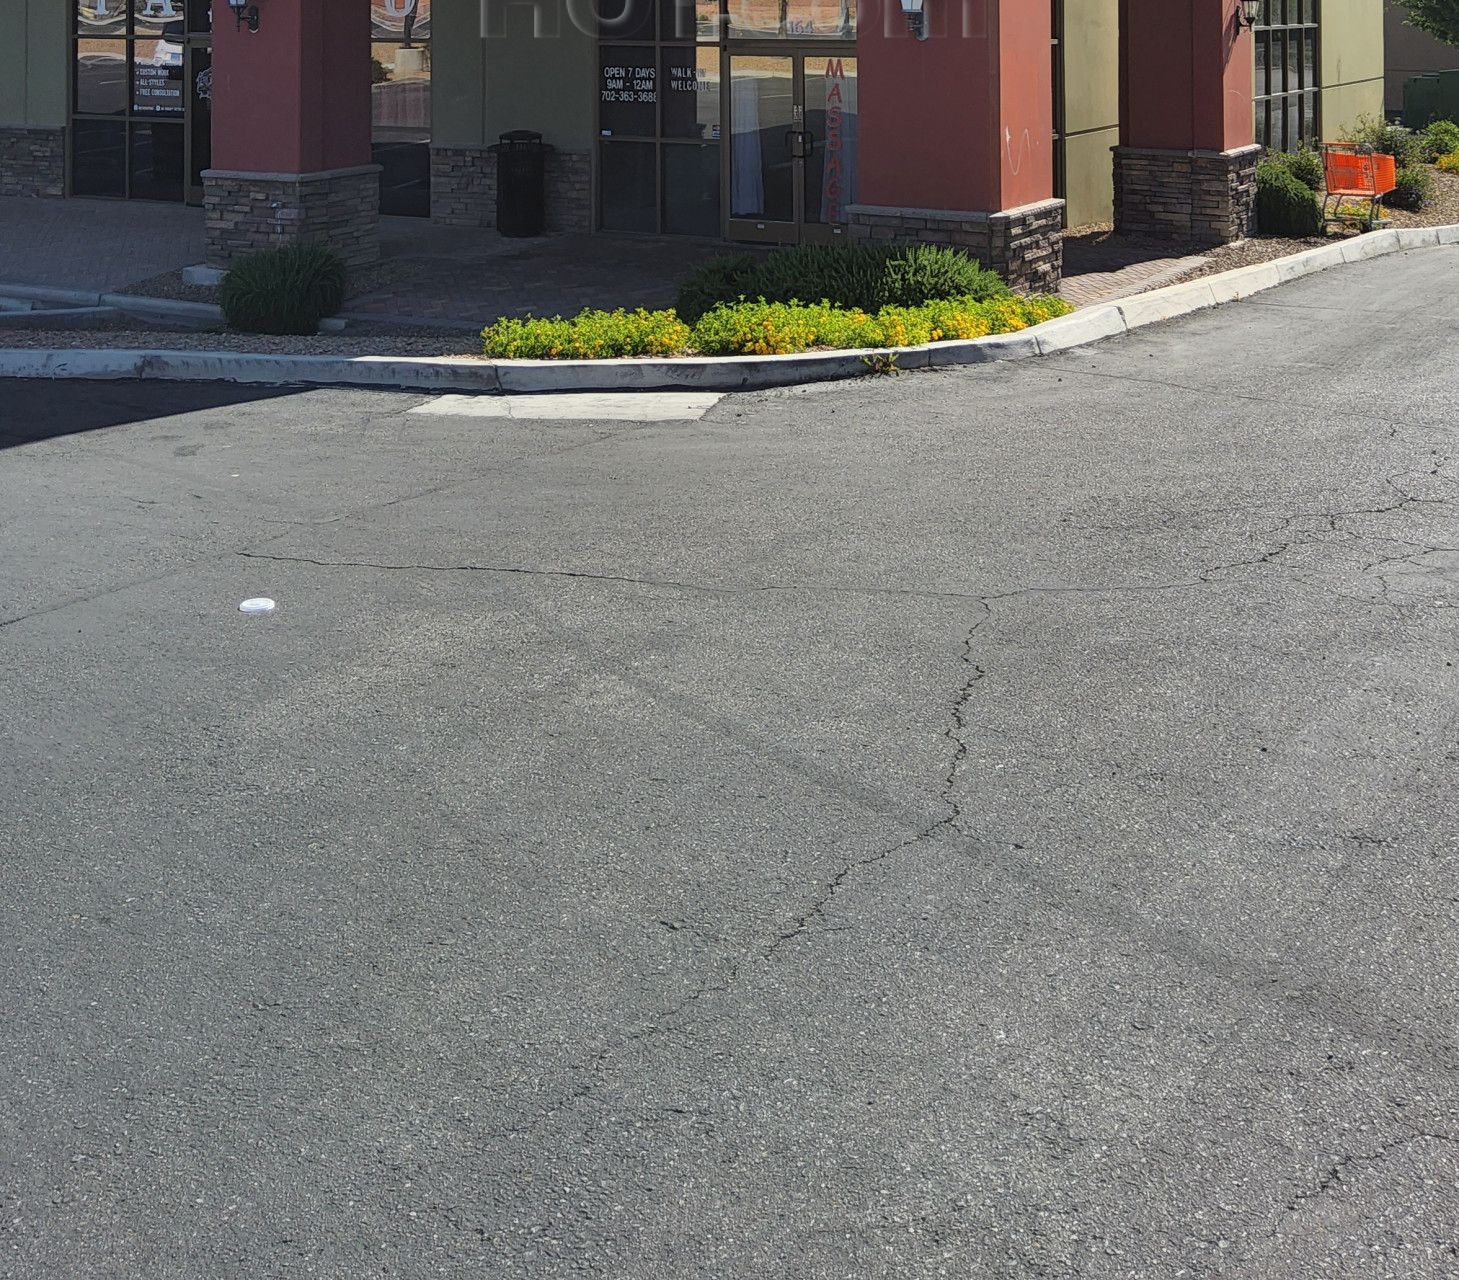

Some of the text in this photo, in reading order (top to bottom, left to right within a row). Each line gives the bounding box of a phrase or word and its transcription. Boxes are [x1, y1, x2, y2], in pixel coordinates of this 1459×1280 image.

[604, 67, 656, 79] OPEN 7 DAYS
[606, 79, 624, 90] 9AM
[633, 80, 653, 91] 12AM
[670, 80, 711, 91] WELCOME
[825, 58, 845, 224] MASSAGE
